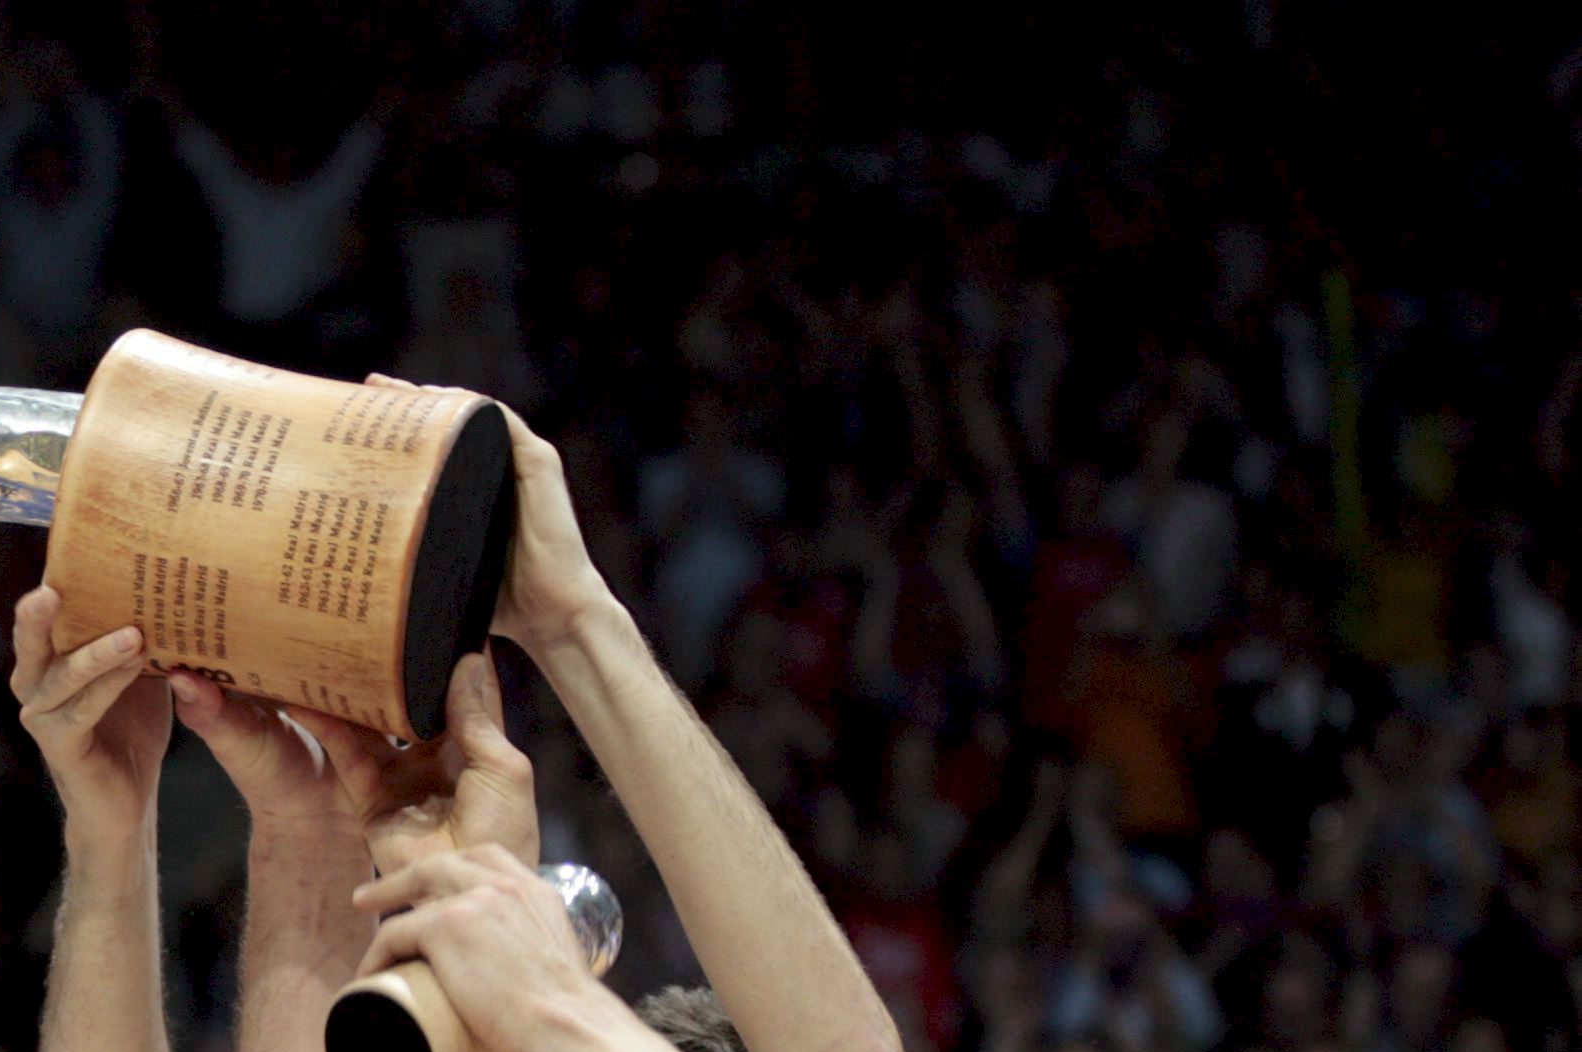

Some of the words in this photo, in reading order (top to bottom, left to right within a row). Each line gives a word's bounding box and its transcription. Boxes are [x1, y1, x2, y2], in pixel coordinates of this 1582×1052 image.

[203, 438, 219, 460] Real
[223, 442, 239, 464] Real
[243, 446, 259, 468] Real
[263, 450, 279, 473] Real
[290, 490, 309, 531] Madrid
[309, 493, 329, 534] Madrid
[329, 497, 349, 538] Madrid
[349, 500, 369, 541] Madrid
[369, 503, 388, 545] Madrid
[284, 534, 298, 560] Real
[304, 537, 318, 564] Real
[323, 541, 338, 569] Real
[342, 545, 357, 573] Real
[363, 549, 376, 577] Real
[133, 554, 147, 591] Madrid
[154, 557, 168, 594] Madrid
[195, 565, 209, 601] Madrid
[215, 569, 229, 606] Madrid
[279, 564, 293, 604] 1961-62
[298, 567, 313, 609] 1962-63
[133, 594, 145, 616] Real
[153, 598, 166, 619] Real
[318, 572, 332, 613] 1963-64
[338, 576, 352, 619] 1964-65
[357, 580, 372, 623] 1965-66
[194, 605, 207, 625] Real
[215, 608, 227, 630] Real
